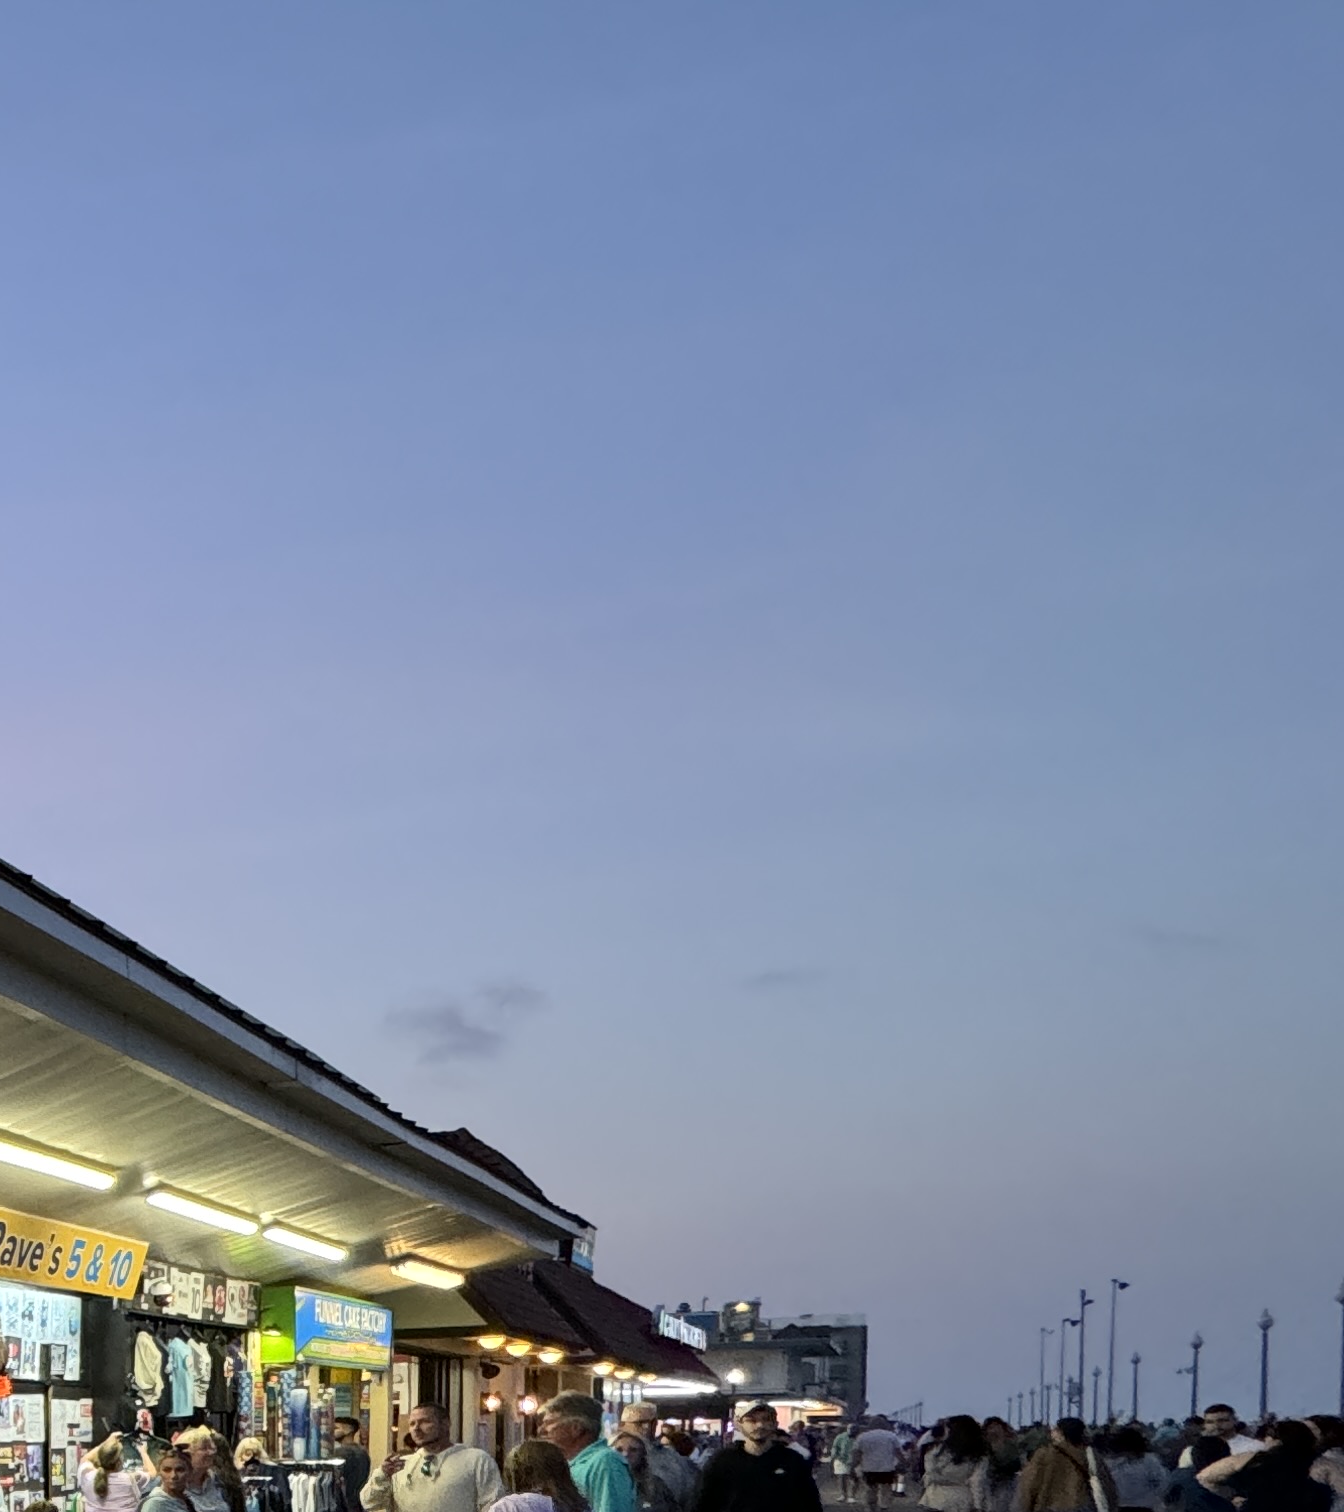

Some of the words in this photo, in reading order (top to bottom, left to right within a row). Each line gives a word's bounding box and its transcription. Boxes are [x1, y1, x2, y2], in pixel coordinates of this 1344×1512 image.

[66, 1239, 86, 1278] 5
[85, 1244, 103, 1282] &
[110, 1249, 133, 1287] 10
